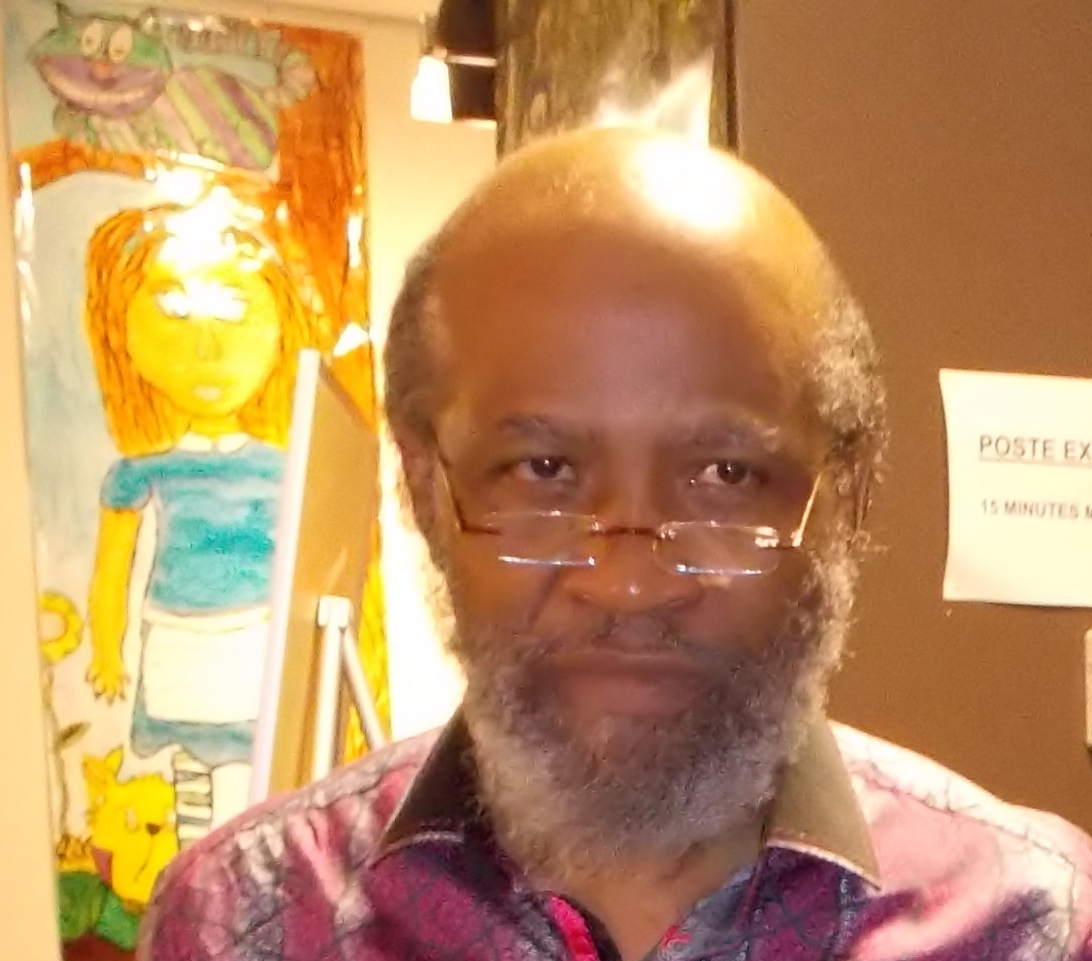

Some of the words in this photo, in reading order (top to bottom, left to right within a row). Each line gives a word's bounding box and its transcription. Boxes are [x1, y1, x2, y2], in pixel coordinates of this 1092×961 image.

[979, 434, 1055, 460] POSTE
[982, 499, 999, 515] 15
[1003, 500, 1080, 520] MINUTES
